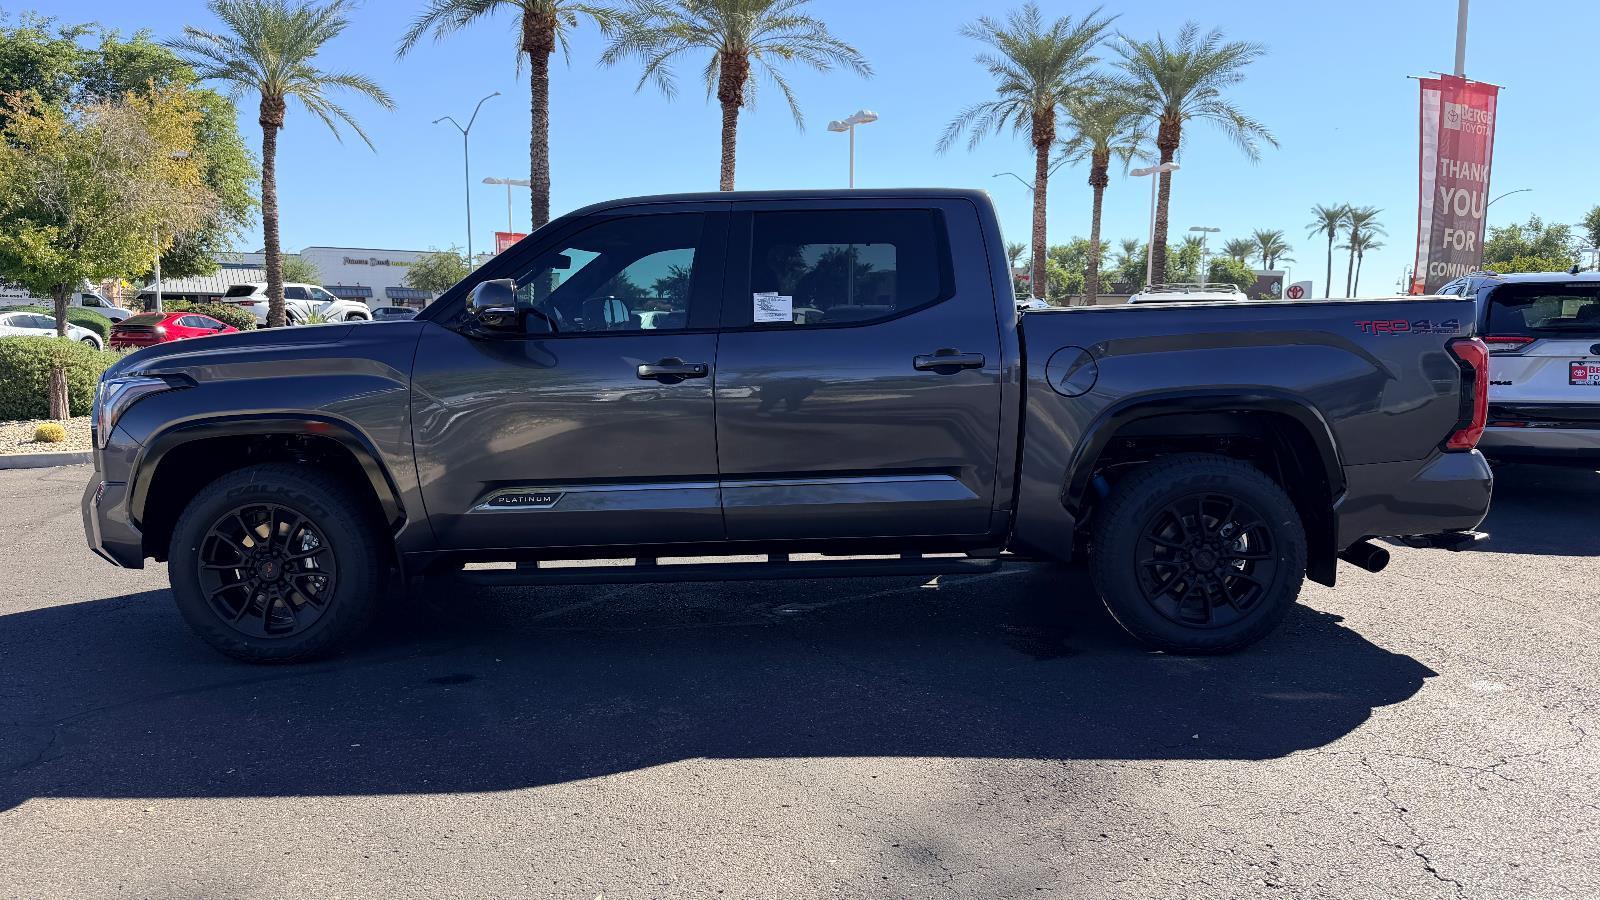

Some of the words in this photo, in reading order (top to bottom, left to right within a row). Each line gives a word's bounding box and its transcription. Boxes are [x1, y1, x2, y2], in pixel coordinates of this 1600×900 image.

[1461, 104, 1493, 123] BERGE
[1462, 121, 1491, 136] TOYOTA
[1441, 158, 1489, 183] THANK
[1440, 186, 1485, 219] YOU
[1443, 227, 1476, 252] FOR
